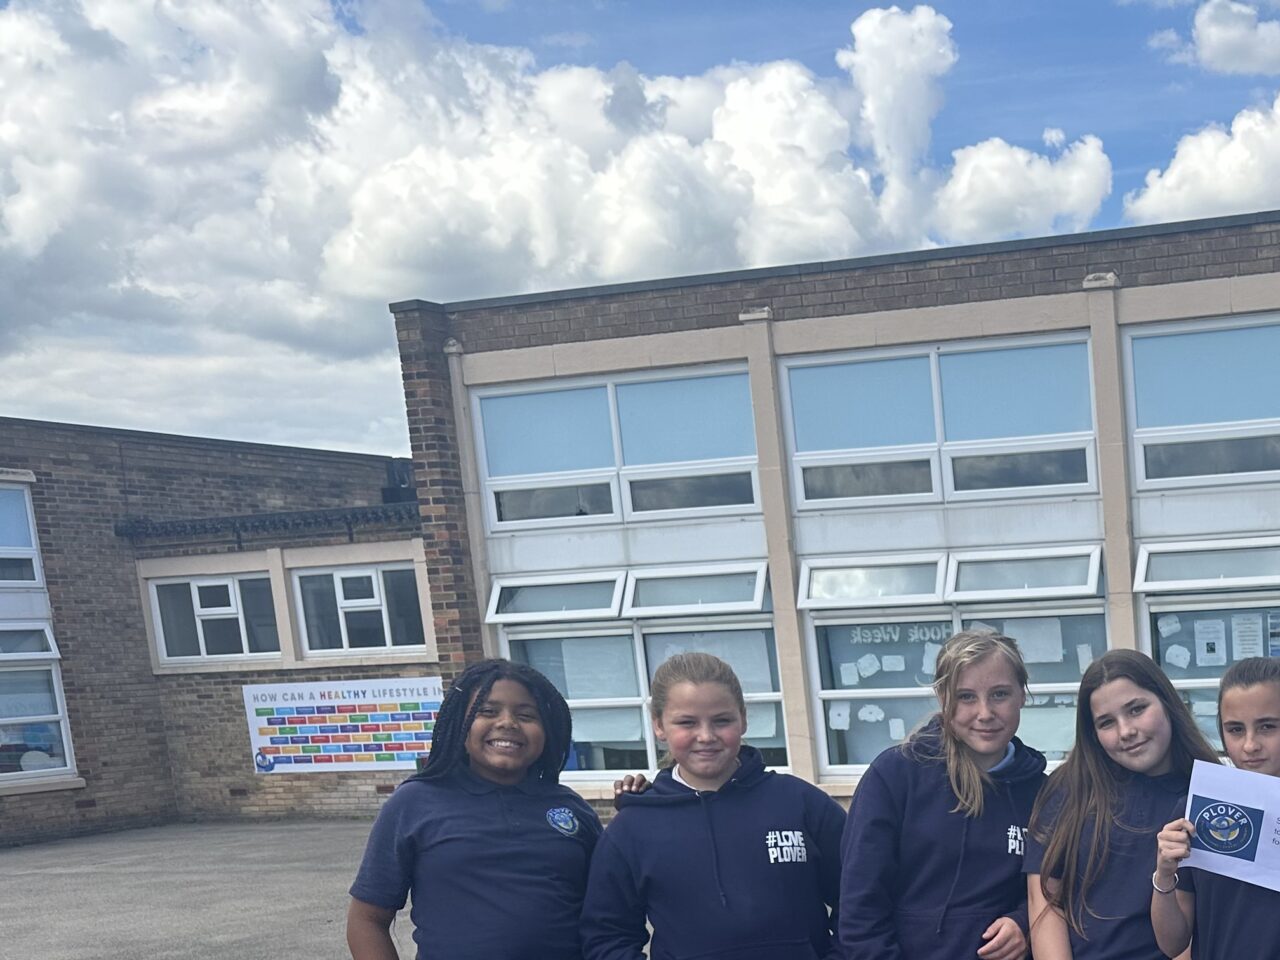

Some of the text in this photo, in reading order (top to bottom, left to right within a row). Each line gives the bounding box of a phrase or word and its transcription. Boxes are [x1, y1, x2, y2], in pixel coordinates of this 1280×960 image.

[253, 693, 277, 703] HOW
[282, 691, 305, 701] CAN
[309, 691, 316, 700] A
[320, 689, 367, 700] HEALTHY
[372, 686, 429, 698] LIFESTYLE
[1202, 805, 1248, 827] PLOVER
[765, 831, 805, 847] #LOVE
[768, 846, 807, 863] PLOVER
